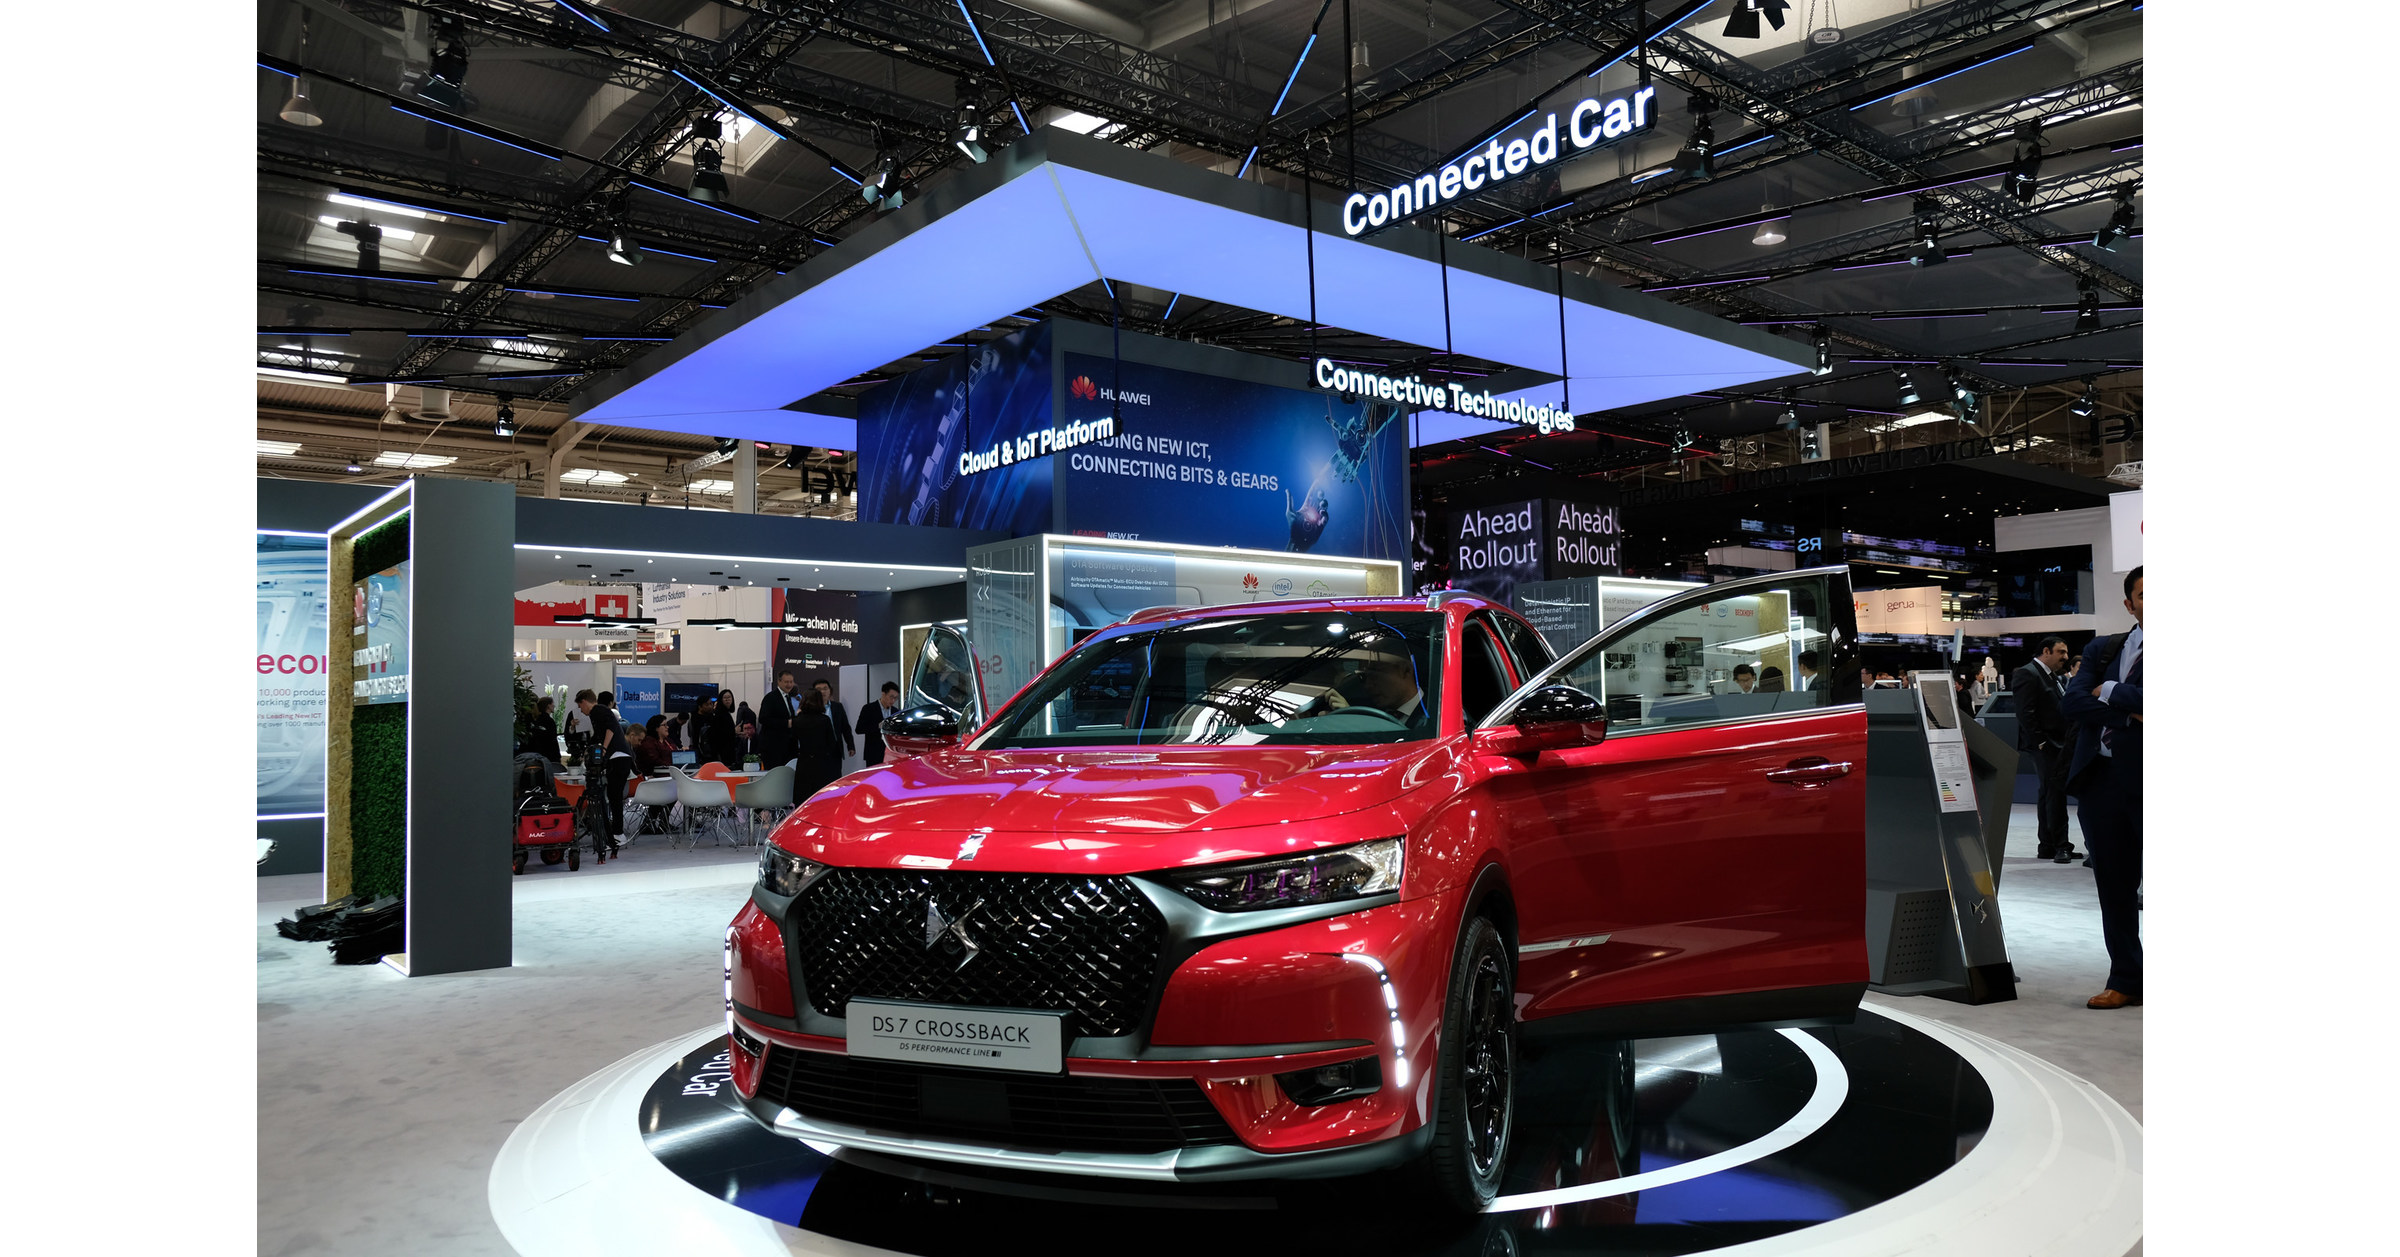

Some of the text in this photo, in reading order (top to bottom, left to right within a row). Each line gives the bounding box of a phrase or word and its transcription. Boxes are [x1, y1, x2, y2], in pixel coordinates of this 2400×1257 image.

[1343, 86, 1655, 236] Connected Car
[1101, 388, 1151, 406] HUAWEI
[1316, 358, 1575, 435] Connective Technologies
[959, 416, 1114, 476] Cloud & IoT Platform
[1147, 436, 1183, 456] NEW
[1186, 440, 1212, 462] ICT,
[1071, 453, 1279, 492] CONNECTING BITS & GEARS
[1459, 502, 1532, 540] Ahead
[1558, 503, 1613, 535] Ahead
[1107, 531, 1127, 540] NEW
[1459, 538, 1538, 571] Rollout
[1557, 536, 1617, 566] Rollout
[829, 618, 841, 631] IoT
[1536, 607, 1562, 615] Ethernet
[594, 629, 629, 637] Switzerland.
[623, 691, 660, 702] DataRobot
[872, 1016, 1031, 1044] DS 7 CROSSBACK
[899, 1042, 991, 1057] DS PERFORMANCE LINE
[681, 1072, 732, 1097] Car
